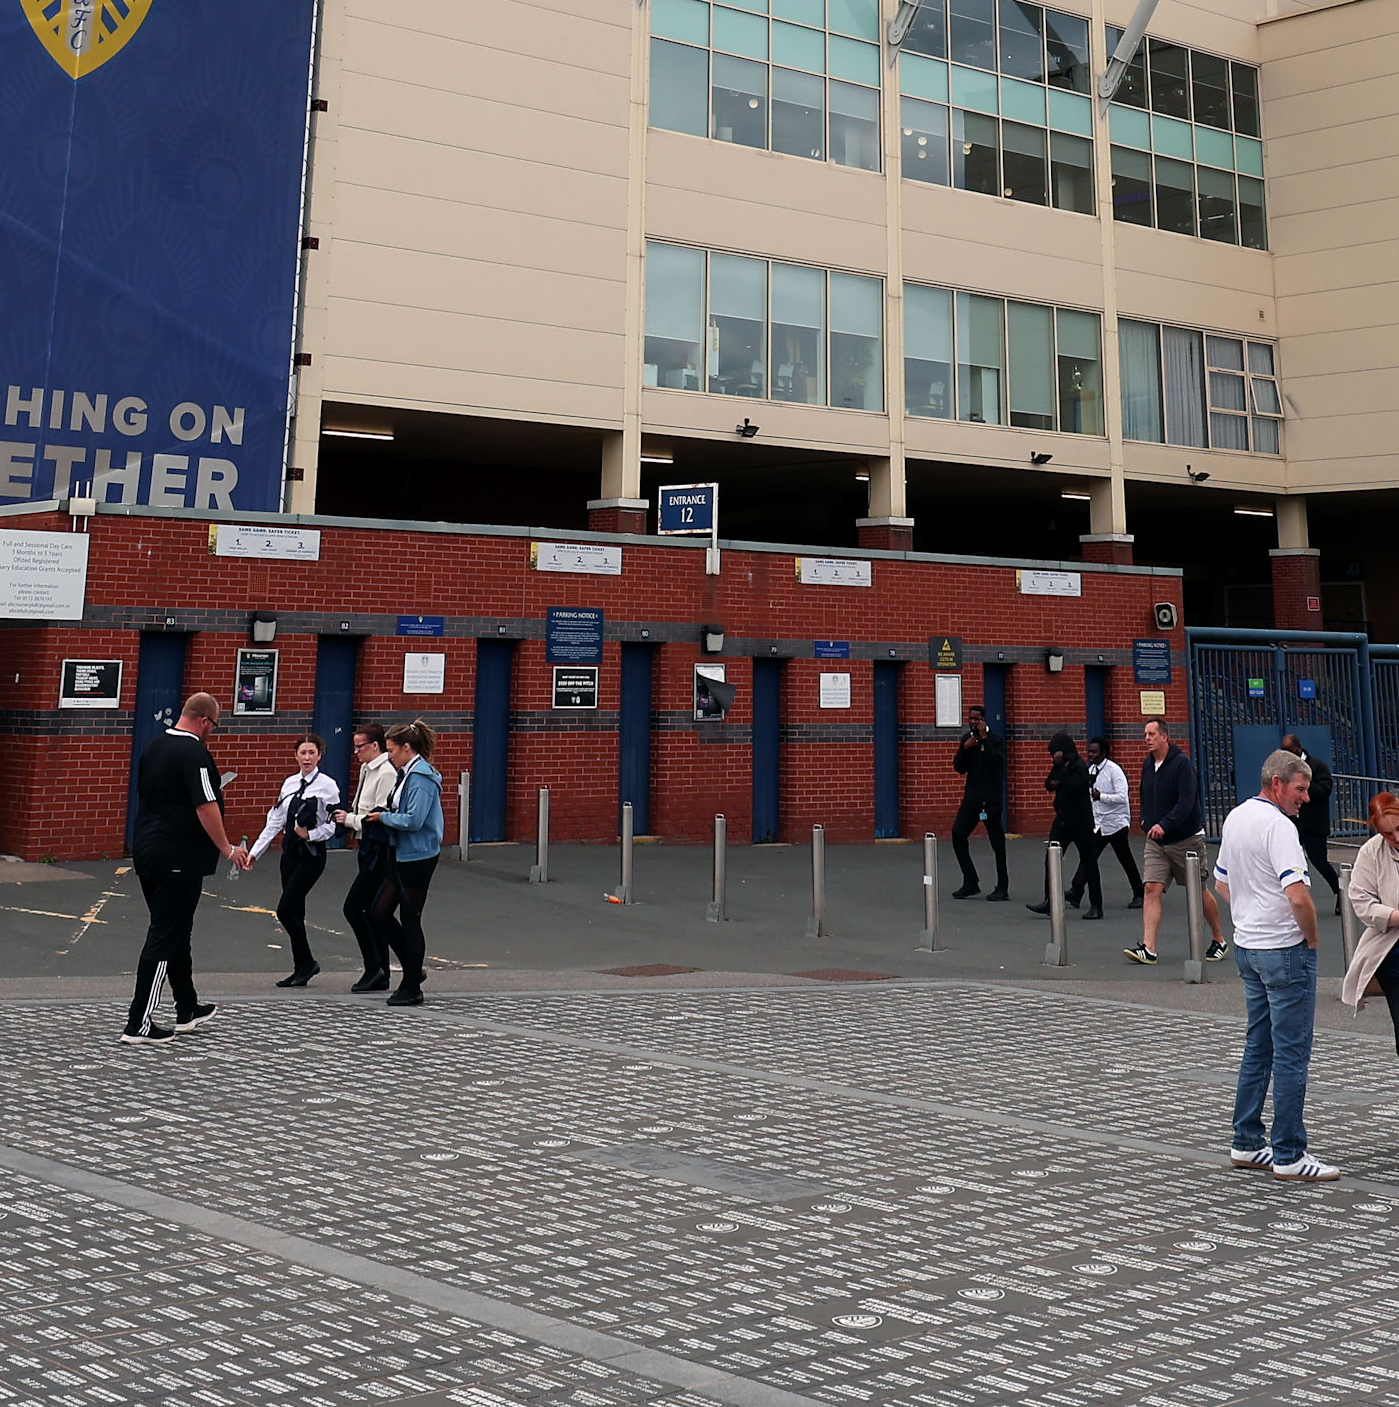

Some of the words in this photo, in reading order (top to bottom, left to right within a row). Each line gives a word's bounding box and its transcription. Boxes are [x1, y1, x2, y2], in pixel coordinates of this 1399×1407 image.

[170, 401, 246, 446] ON
[669, 495, 706, 506] ENTRANCE
[681, 507, 694, 523] 12
[32, 557, 59, 565] Registered
